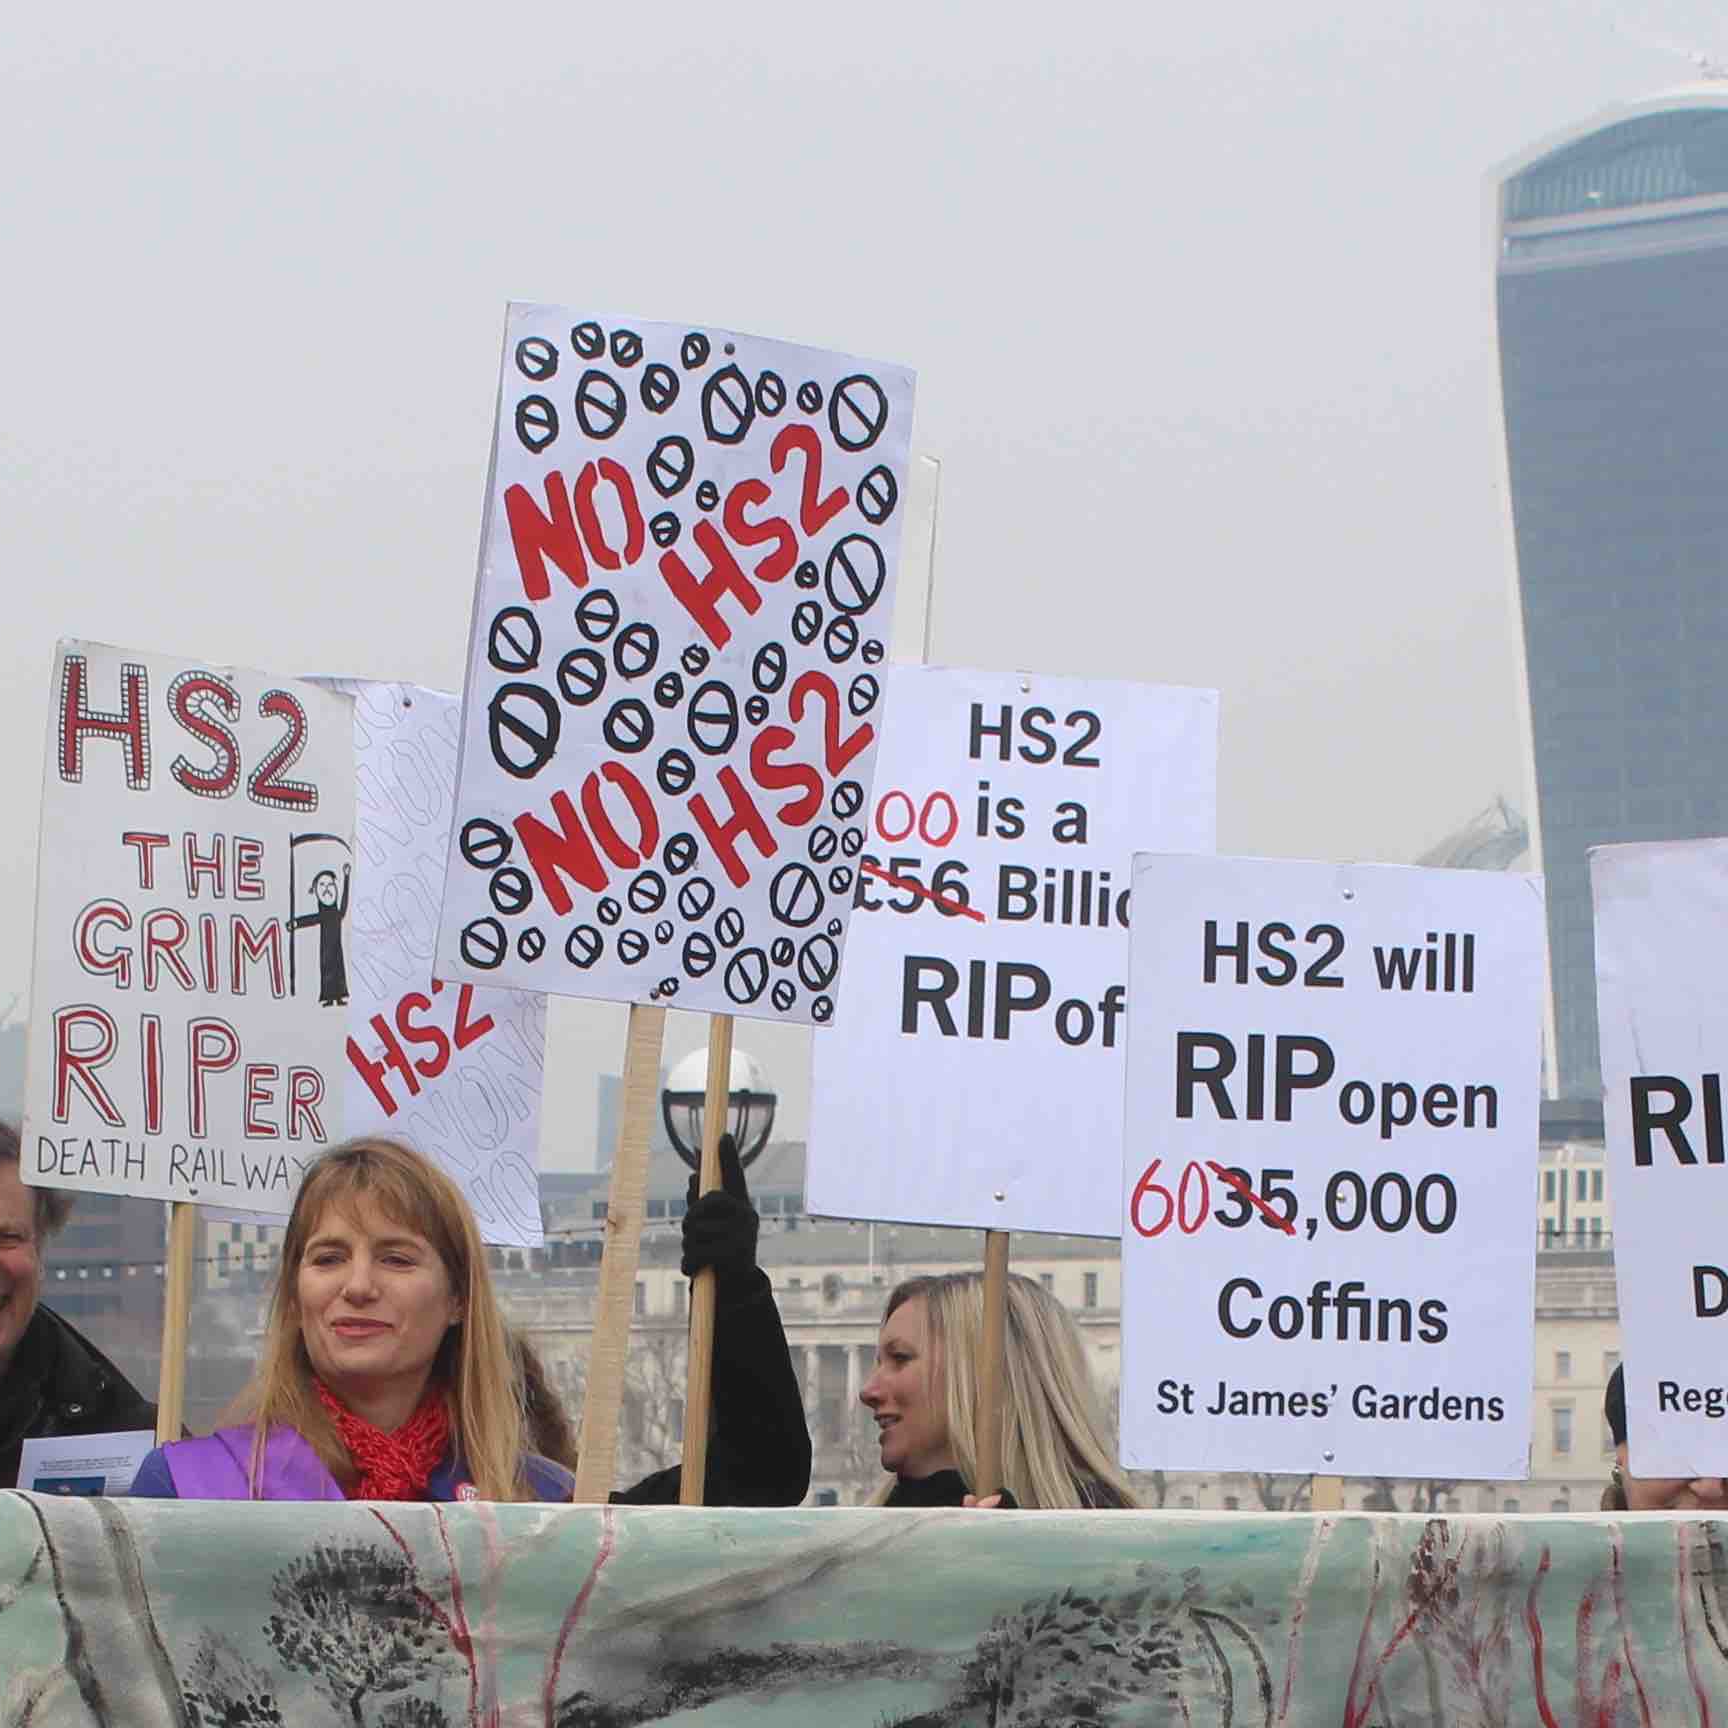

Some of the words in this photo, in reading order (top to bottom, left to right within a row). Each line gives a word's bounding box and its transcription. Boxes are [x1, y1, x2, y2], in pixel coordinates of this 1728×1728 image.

[503, 457, 646, 602] NO
[658, 422, 851, 650] HS2
[59, 655, 319, 812] HS2
[968, 702, 1102, 768] HS2
[514, 760, 661, 916] NO
[688, 670, 874, 888] HS2
[976, 780, 1026, 840] is
[1052, 801, 1088, 845] a
[122, 831, 266, 900] THE
[997, 864, 1130, 928] Billi
[74, 898, 285, 998] GRIM
[1202, 919, 1345, 988] HS2
[1374, 933, 1475, 993] will
[52, 1003, 328, 1143] RIPER
[346, 978, 495, 1117] HS2
[37, 1136, 146, 1182] DEATH
[1217, 1277, 1449, 1344] Coffins
[1156, 1379, 1194, 1415] St
[1207, 1381, 1338, 1418] James'
[1351, 1384, 1505, 1422] Gardens
